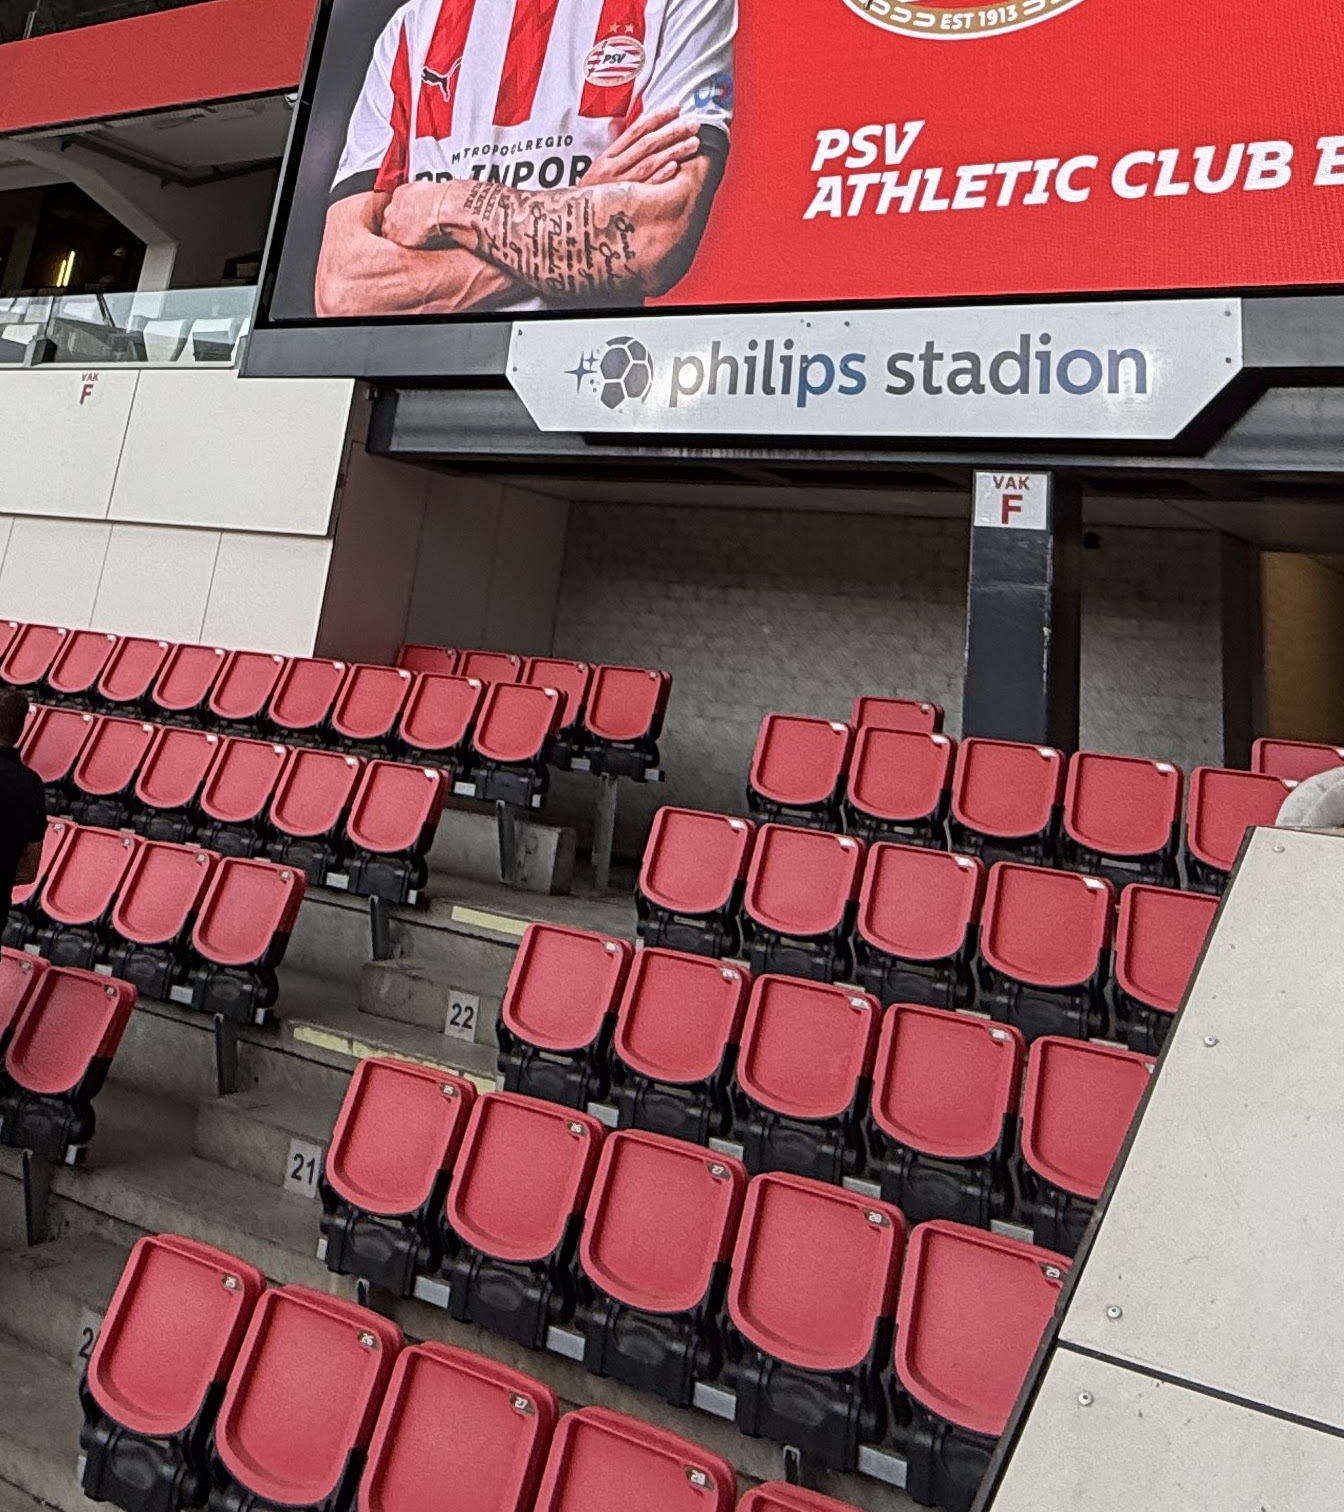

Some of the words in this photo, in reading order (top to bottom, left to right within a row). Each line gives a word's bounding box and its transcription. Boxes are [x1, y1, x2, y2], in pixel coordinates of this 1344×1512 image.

[940, 11, 975, 30] EST
[978, 4, 1019, 27] 1913
[602, 53, 627, 65] PSV
[810, 120, 926, 172] PSV
[802, 155, 1099, 220] ATHLETIC
[1111, 140, 1295, 200] CLUB
[669, 337, 866, 408] philips
[886, 333, 1148, 396] stadion
[79, 383, 94, 405] F
[992, 474, 1031, 491] VAK
[1001, 493, 1023, 525] F
[449, 1002, 474, 1030] 22
[290, 1152, 316, 1184] 21
[711, 1164, 724, 1175] 27
[78, 1327, 96, 1359] 2
[360, 1333, 375, 1346] 26
[513, 1396, 528, 1409] 27
[689, 1470, 706, 1486] 28
